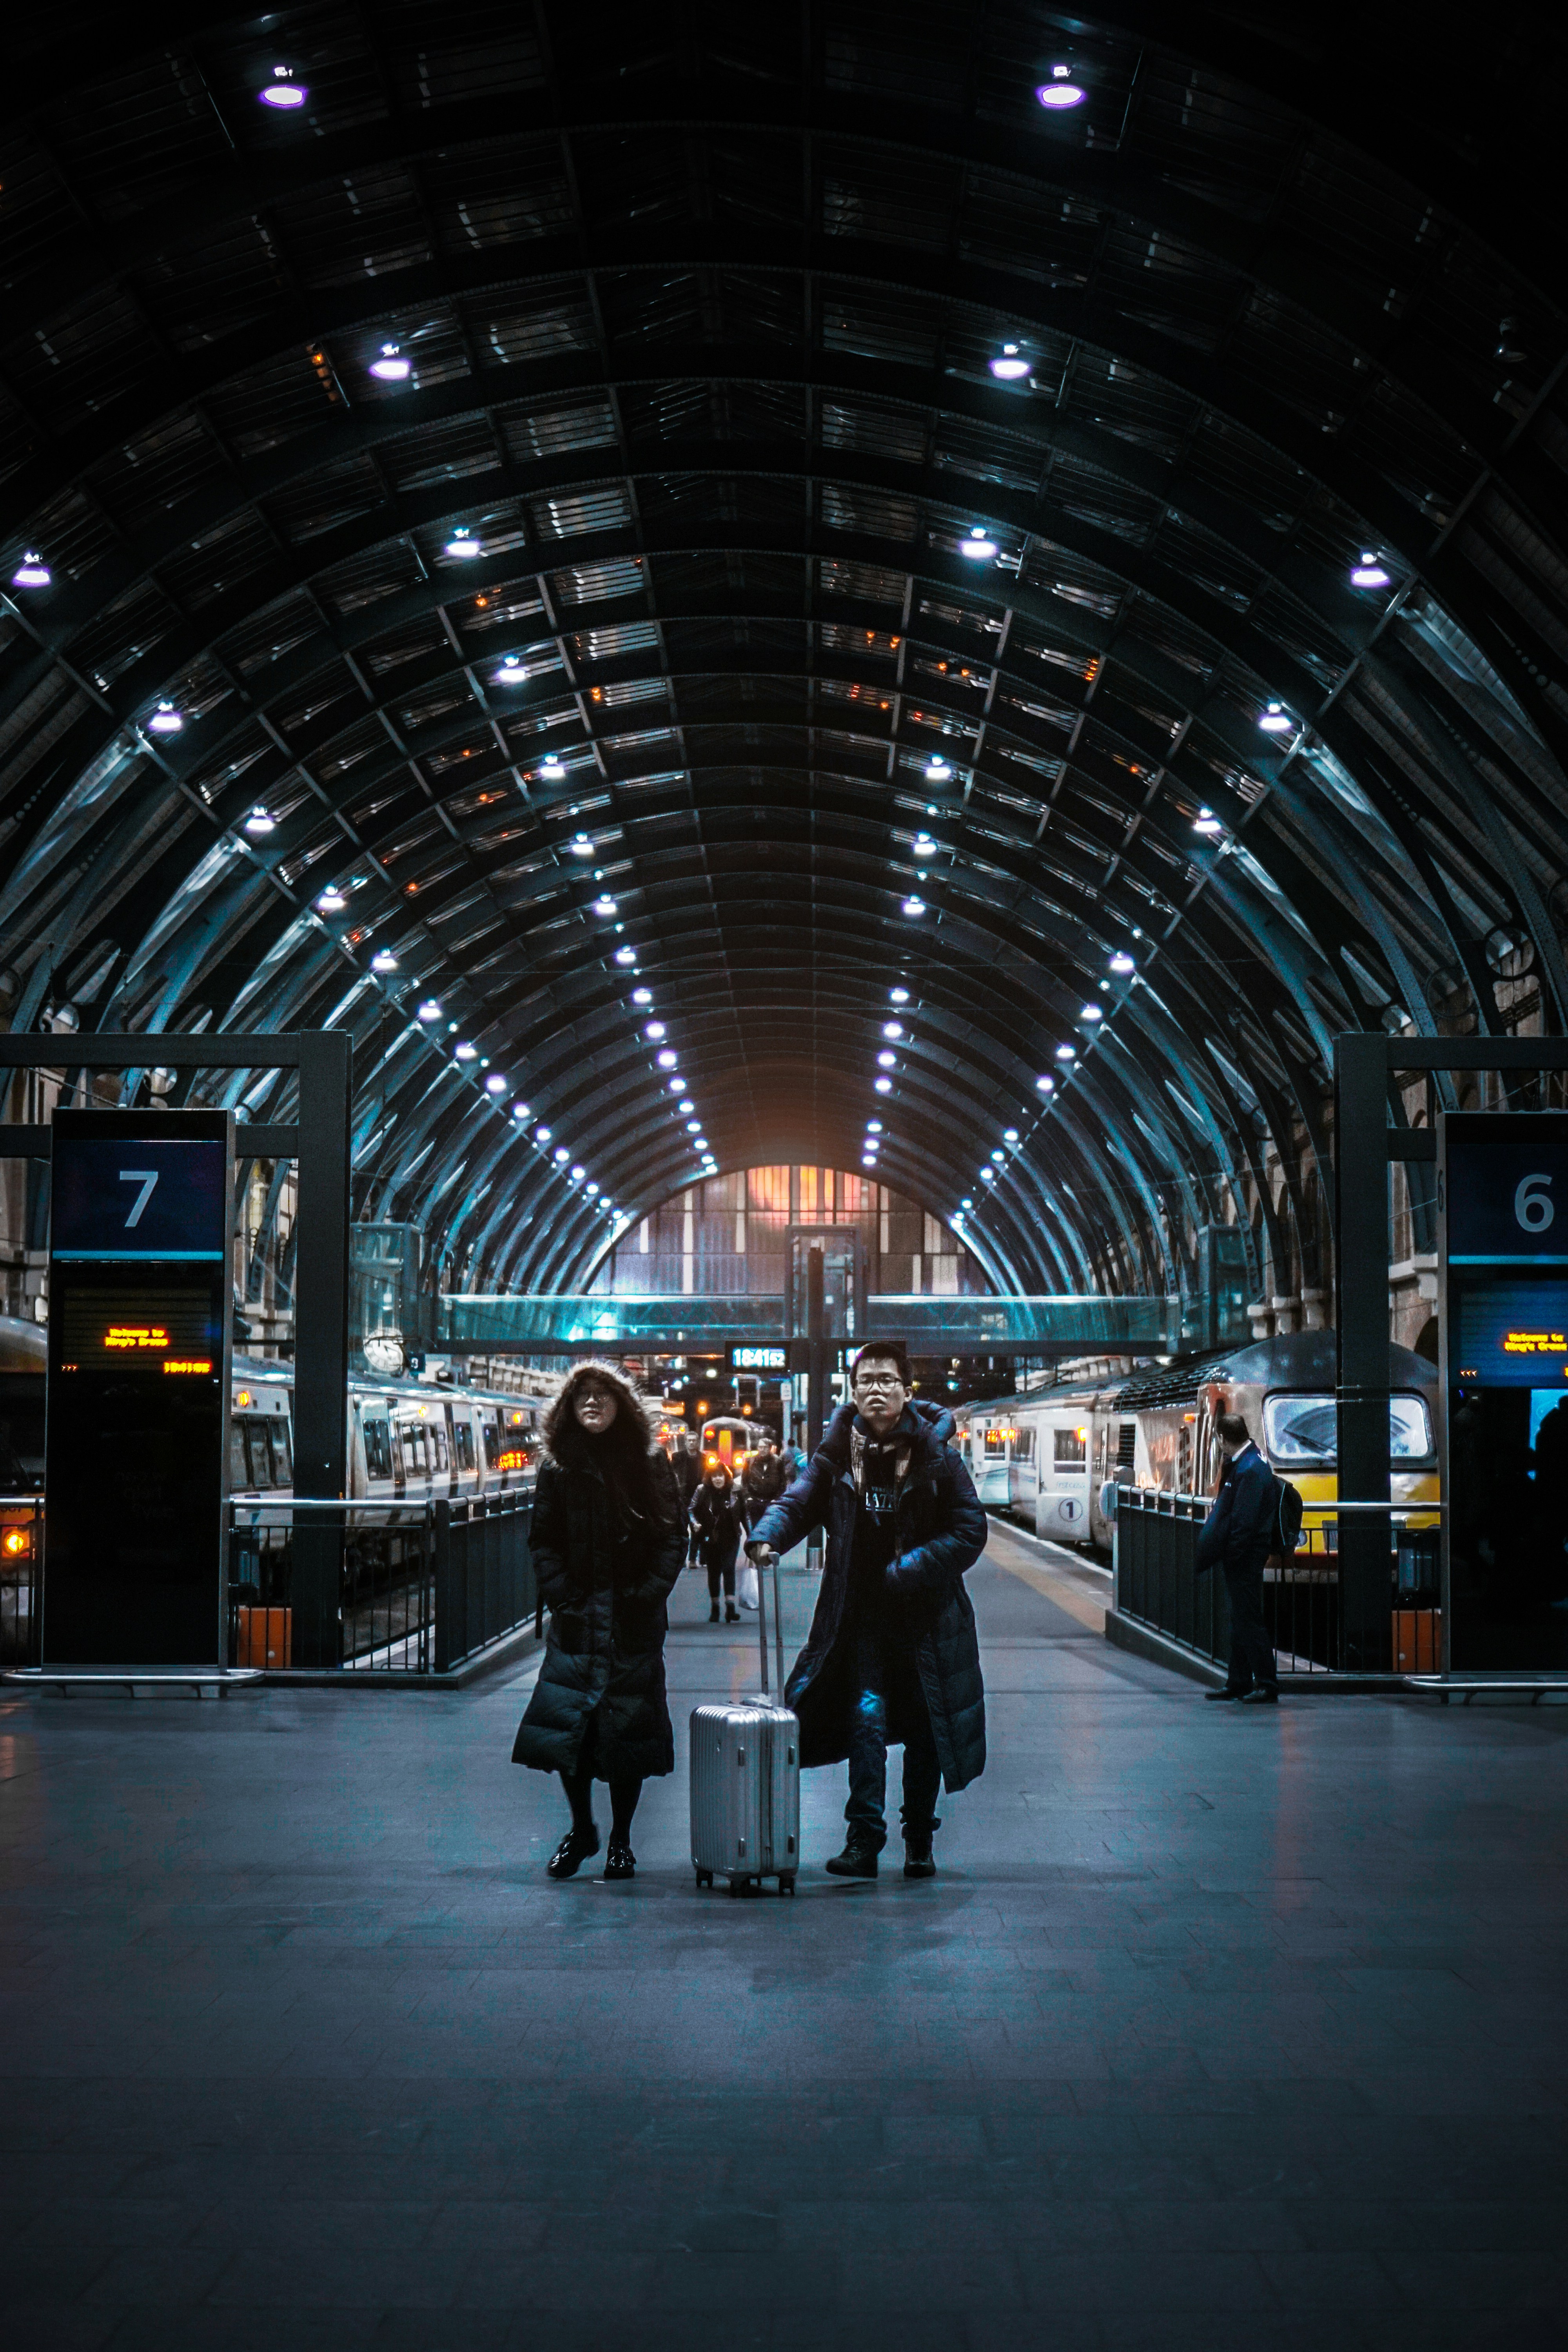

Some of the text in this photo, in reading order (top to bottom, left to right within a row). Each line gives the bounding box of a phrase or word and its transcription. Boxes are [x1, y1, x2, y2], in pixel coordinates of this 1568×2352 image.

[1438, 1169, 1443, 1212] 6
[120, 1171, 158, 1227] 7
[1515, 1174, 1554, 1232] 6
[109, 1328, 165, 1338] Welcome to
[1508, 1333, 1564, 1342] Welcome to
[105, 1336, 169, 1347] King's Cross
[1504, 1341, 1567, 1352] King's Cross
[1066, 1502, 1073, 1519] 1
